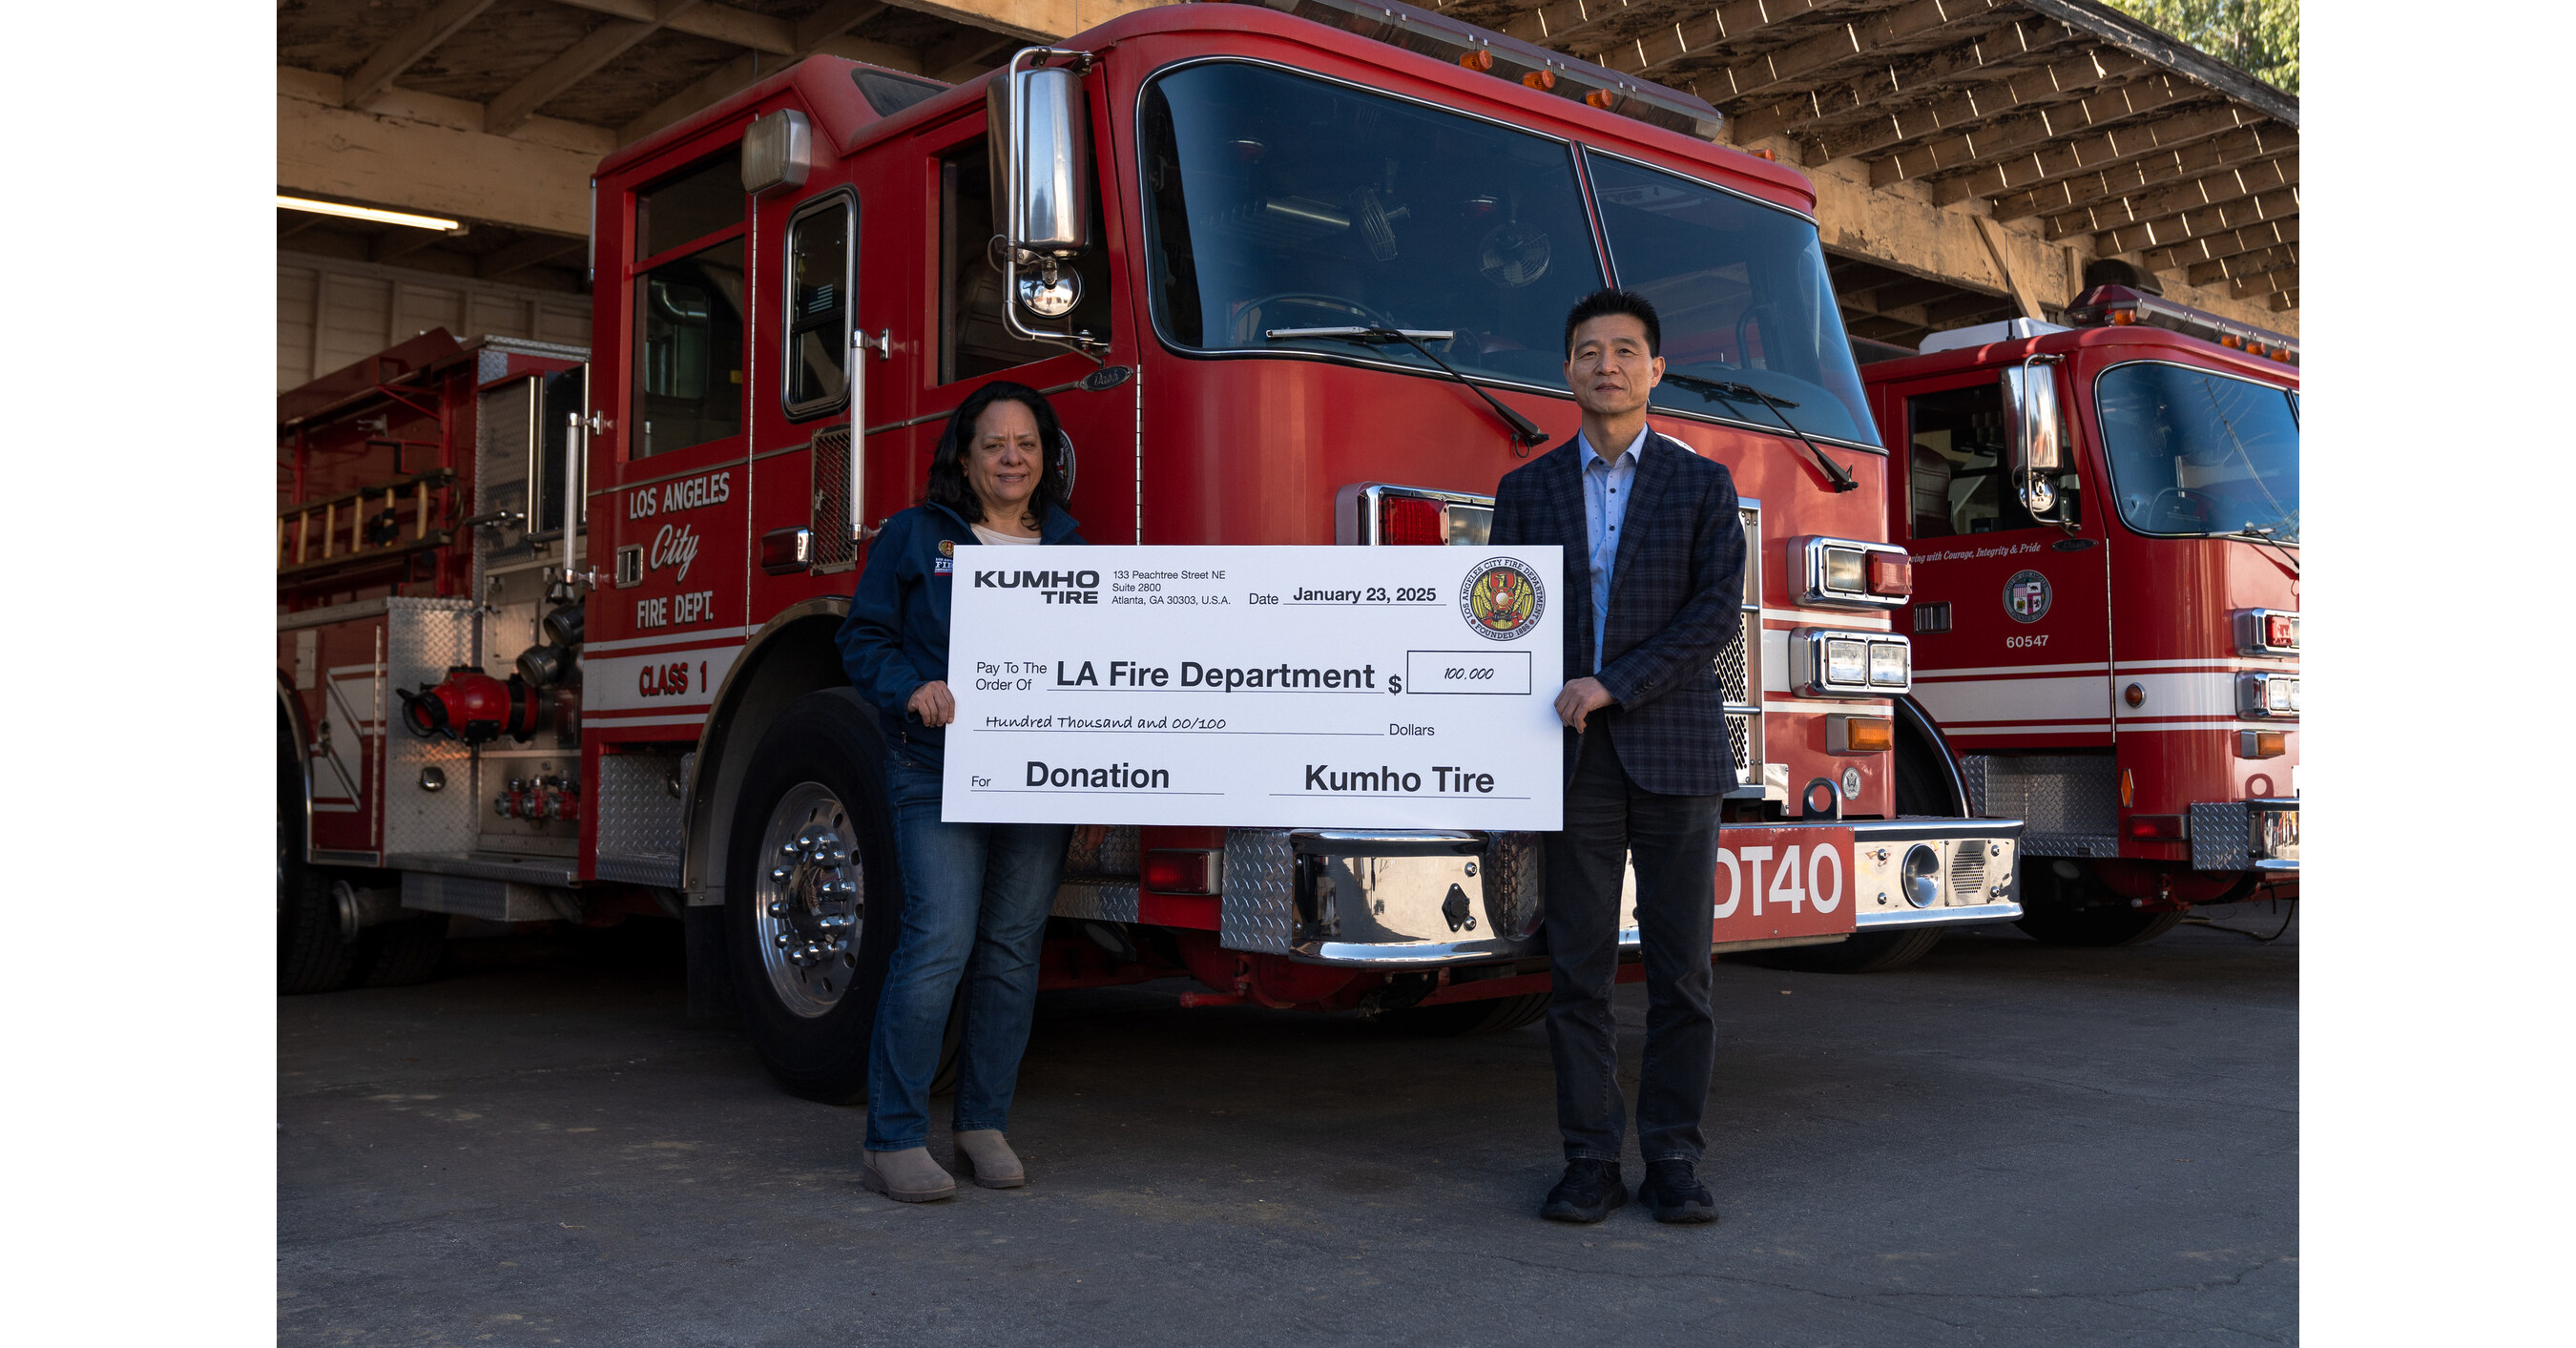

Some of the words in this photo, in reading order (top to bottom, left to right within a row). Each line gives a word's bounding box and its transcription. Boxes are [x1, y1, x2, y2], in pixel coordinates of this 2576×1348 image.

[630, 487, 657, 520] LOS
[662, 471, 730, 513] ANGELES
[650, 523, 700, 582] City
[1926, 551, 1942, 562] with
[1943, 550, 1975, 560] Courage,
[1976, 546, 2009, 558] Integrity
[2009, 544, 2018, 554] &
[2019, 542, 2042, 554] Pride
[1484, 559, 1503, 569] CITY
[1505, 559, 1524, 570] FIRE
[975, 570, 1099, 588] KUMHO
[1113, 570, 1129, 579] 133
[1132, 570, 1178, 579] Peachtree
[1181, 570, 1208, 579] Street
[1213, 570, 1225, 579] NE
[1112, 583, 1135, 591] Suite
[1138, 583, 1161, 591] 2800
[1463, 566, 1484, 601] ANGELES
[1041, 591, 1098, 604] TIRE
[1111, 596, 1146, 605] Atlanta,
[1150, 595, 1164, 604] GA
[1167, 596, 1197, 605] 30303,
[1250, 593, 1278, 605] Date
[1293, 587, 1361, 604] January
[1366, 587, 1391, 603] 23,
[1397, 588, 1436, 601] 2025
[1523, 568, 1543, 619] DEPARTMENT
[636, 596, 668, 630] FIRE
[674, 590, 714, 625] DEPT.
[1463, 603, 1472, 619] LOS
[1475, 623, 1514, 638] FOUNDED
[1515, 623, 1530, 635] 1886
[2006, 634, 2048, 648] 60547
[977, 662, 1000, 676] Pay
[1004, 662, 1019, 674] To
[1024, 662, 1047, 674] The
[639, 662, 689, 697] CLASS
[699, 660, 707, 694] 1
[976, 678, 1012, 690] Order
[1017, 679, 1031, 691] Of
[1057, 661, 1098, 686] LA
[1111, 661, 1169, 687] Fire
[1181, 663, 1375, 693] Department
[1388, 674, 1402, 695] $
[987, 715, 1051, 728] Hundred
[1057, 716, 1132, 728] Thousand
[1138, 716, 1167, 728] and
[1173, 718, 1226, 729] 00/100
[1390, 724, 1434, 736] Dollars
[972, 776, 991, 787] For
[1027, 761, 1169, 788] Donation
[1306, 765, 1421, 792] Kumho
[1432, 767, 1494, 793] Tire
